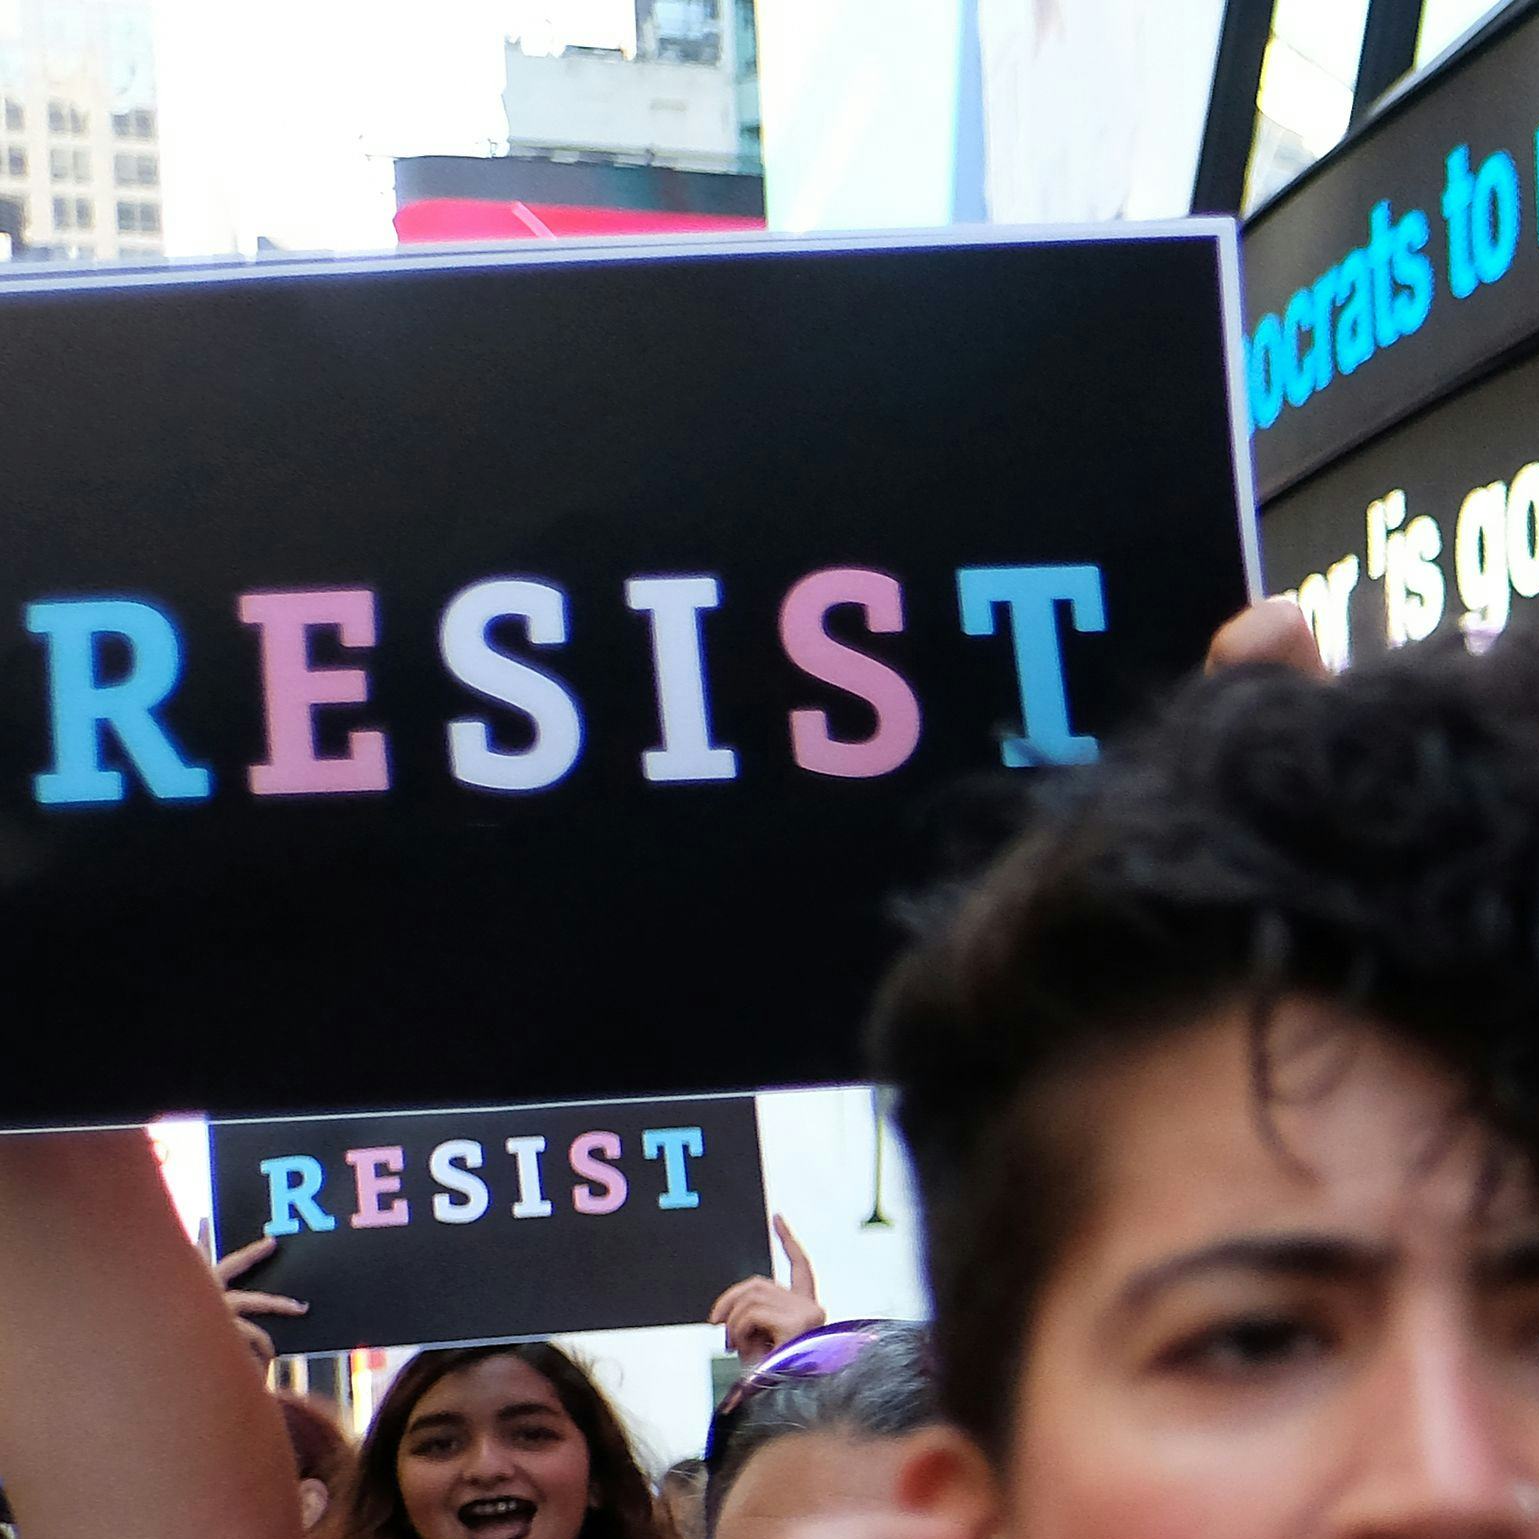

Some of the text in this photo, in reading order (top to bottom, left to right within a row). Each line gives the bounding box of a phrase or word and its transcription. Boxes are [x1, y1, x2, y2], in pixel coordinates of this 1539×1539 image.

[1240, 199, 1436, 440] ocrats
[1441, 144, 1522, 300] to
[25, 563, 1107, 805] RESIST
[258, 1125, 706, 1237] RESIST
